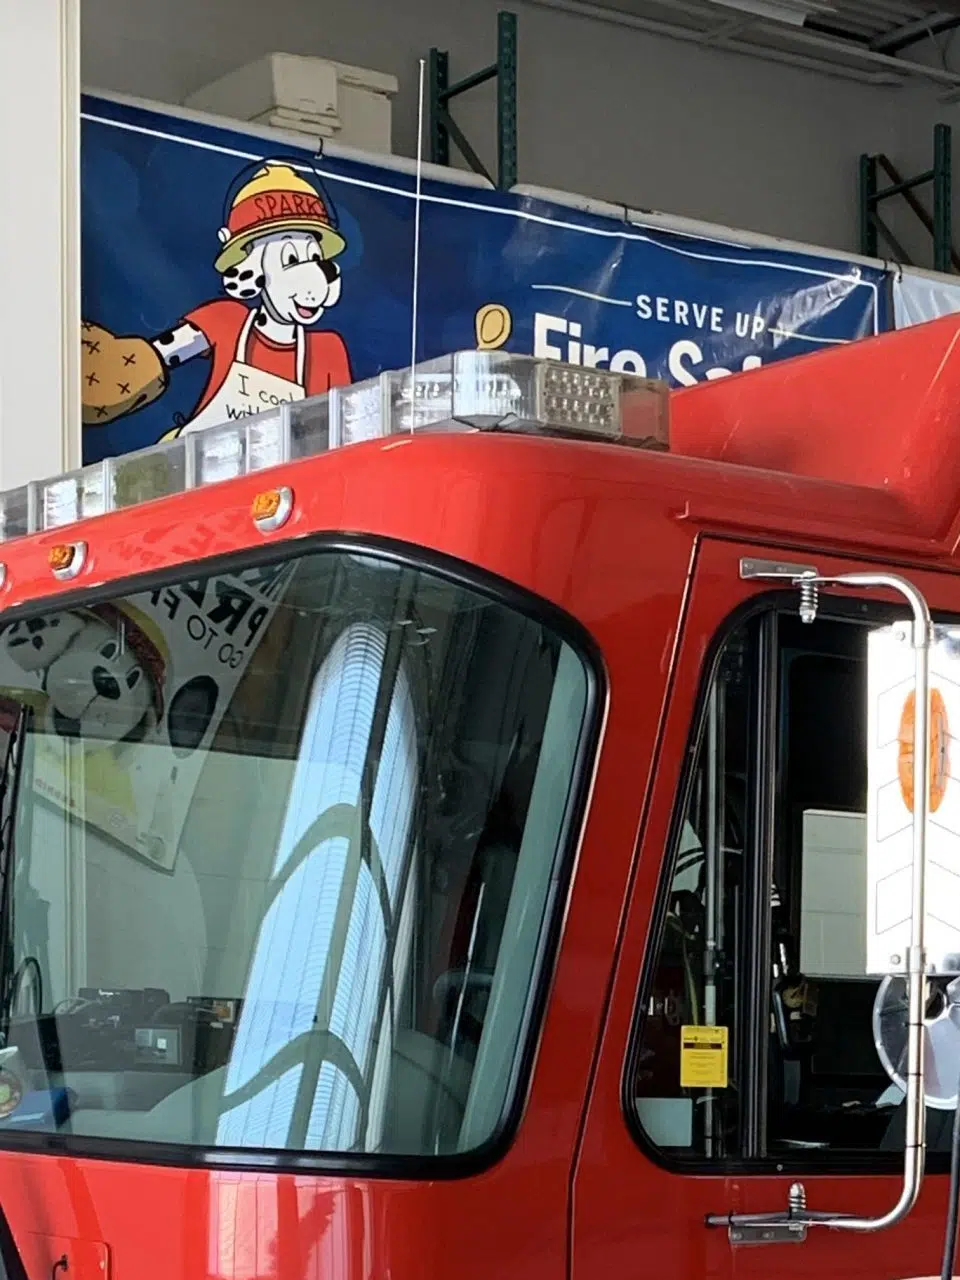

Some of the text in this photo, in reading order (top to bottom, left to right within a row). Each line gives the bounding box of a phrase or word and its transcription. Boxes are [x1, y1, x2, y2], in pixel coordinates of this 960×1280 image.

[635, 294, 765, 341] SERVE UP
[237, 373, 250, 397] I
